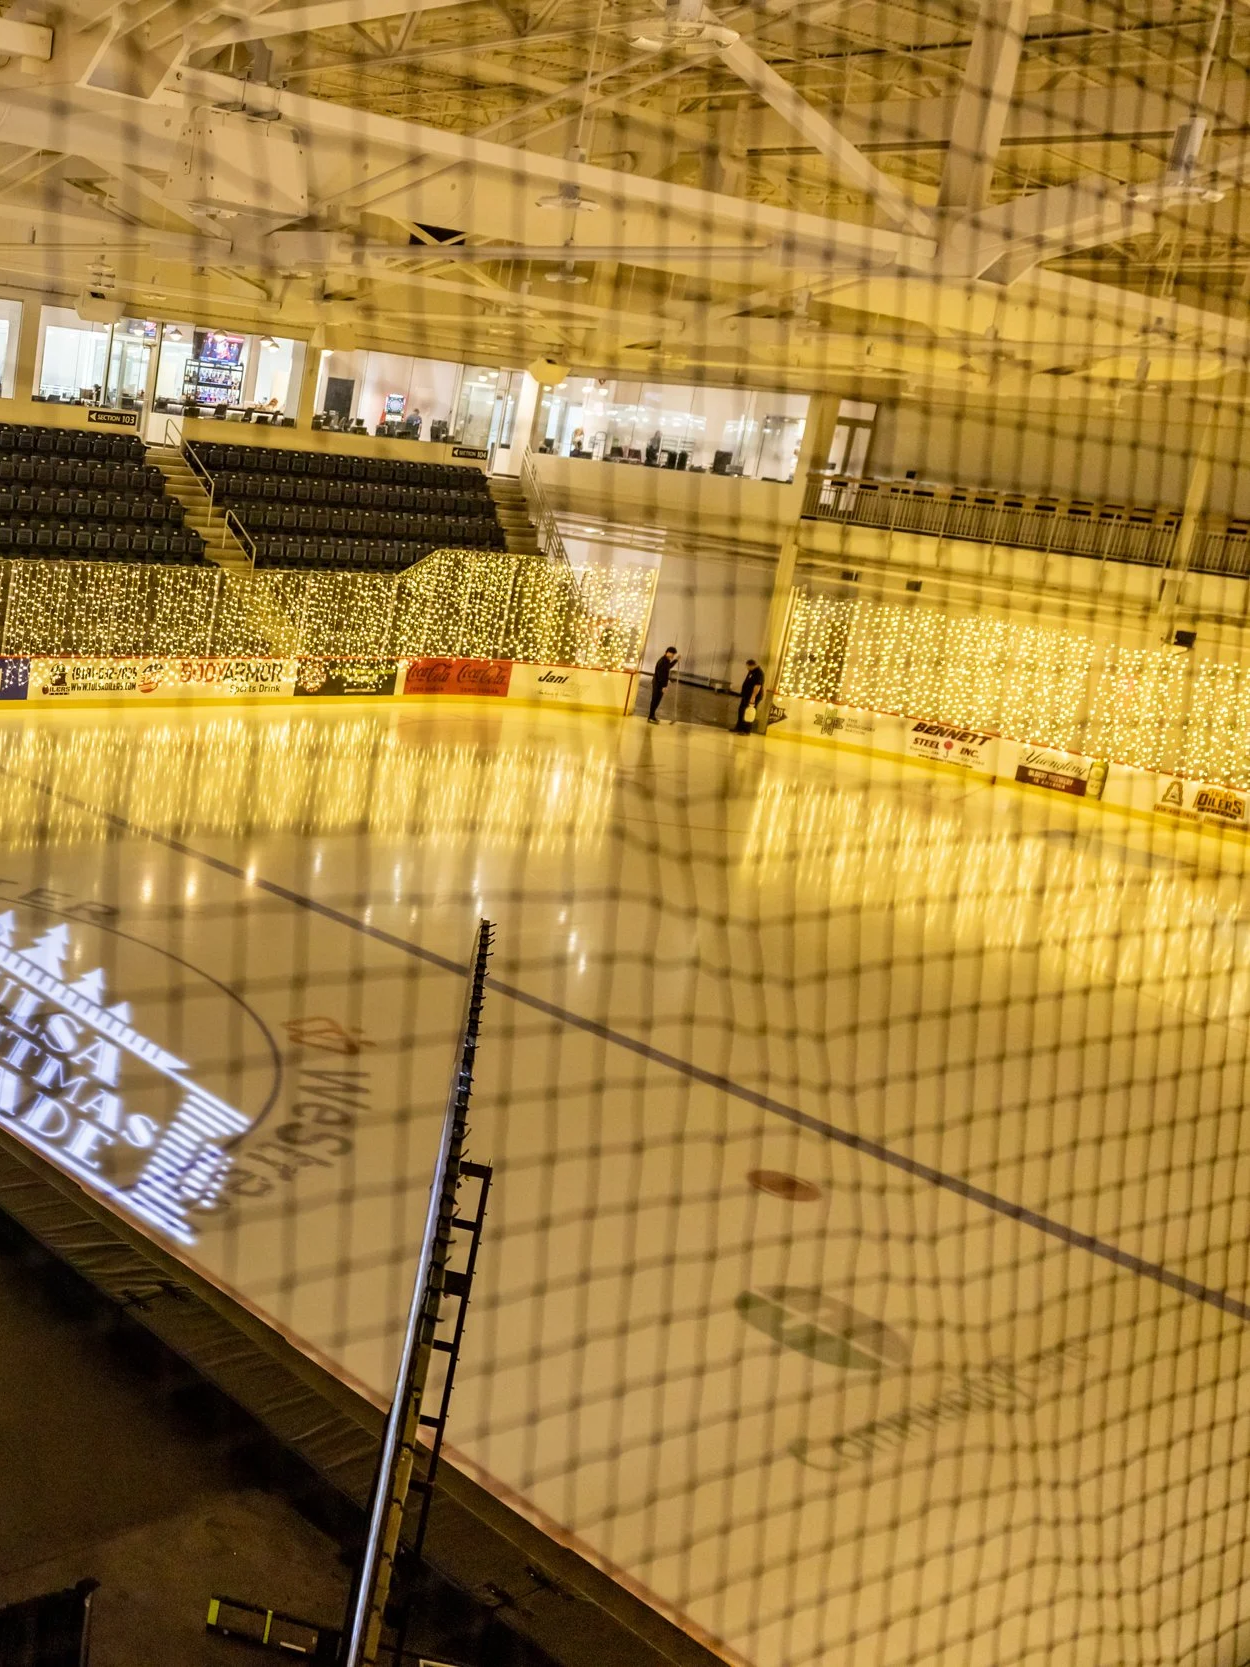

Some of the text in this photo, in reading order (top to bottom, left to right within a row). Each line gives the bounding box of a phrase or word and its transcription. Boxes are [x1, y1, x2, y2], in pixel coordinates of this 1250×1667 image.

[97, 414, 135, 425] SECTION 103
[230, 684, 281, 694] Sports Drink
[912, 721, 993, 746] BENNETT
[913, 737, 940, 749] STEEL
[1196, 793, 1243, 816] OILERS
